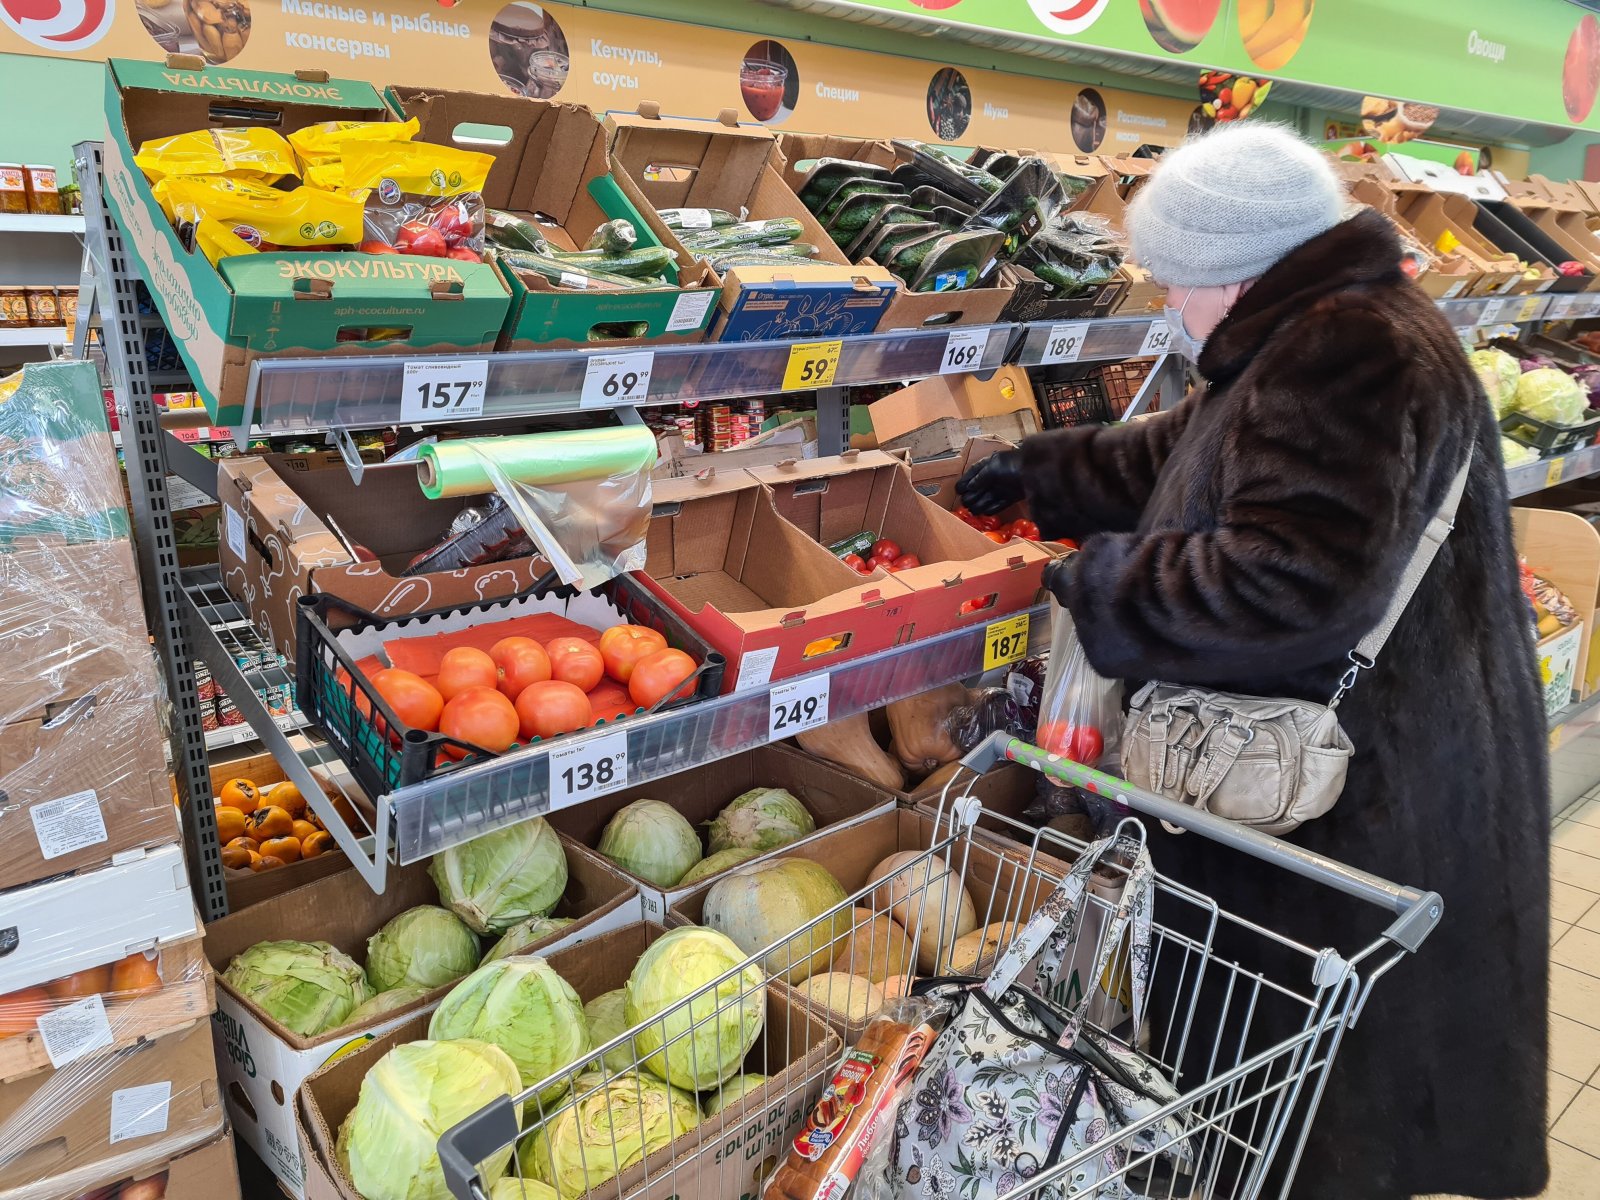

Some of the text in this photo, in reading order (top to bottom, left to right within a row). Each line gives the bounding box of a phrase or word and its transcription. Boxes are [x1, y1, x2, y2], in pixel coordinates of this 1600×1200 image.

[281, 0, 471, 39] Мясные и рыбные
[284, 31, 390, 60] консервы
[590, 38, 663, 68] Кетчупы,
[1467, 30, 1506, 63] Овощи
[161, 72, 343, 101] ЭКОКУЛЬТУРА
[592, 70, 640, 91] соусы
[815, 82, 860, 102] Специи
[983, 102, 1009, 120] Мука
[275, 260, 465, 283] ЭКОКУЛЬТУРА
[333, 306, 426, 316] aph-ecoculture.ru
[1049, 337, 1076, 356] 189
[1147, 332, 1170, 349] 154
[947, 345, 978, 366] 169
[800, 359, 829, 381] 59
[417, 380, 483, 409] 157 99
[602, 372, 638, 397] 69
[992, 632, 1021, 660] 187
[773, 696, 818, 731] 249
[552, 750, 576, 759] Томаты
[561, 752, 626, 794] 138 99
